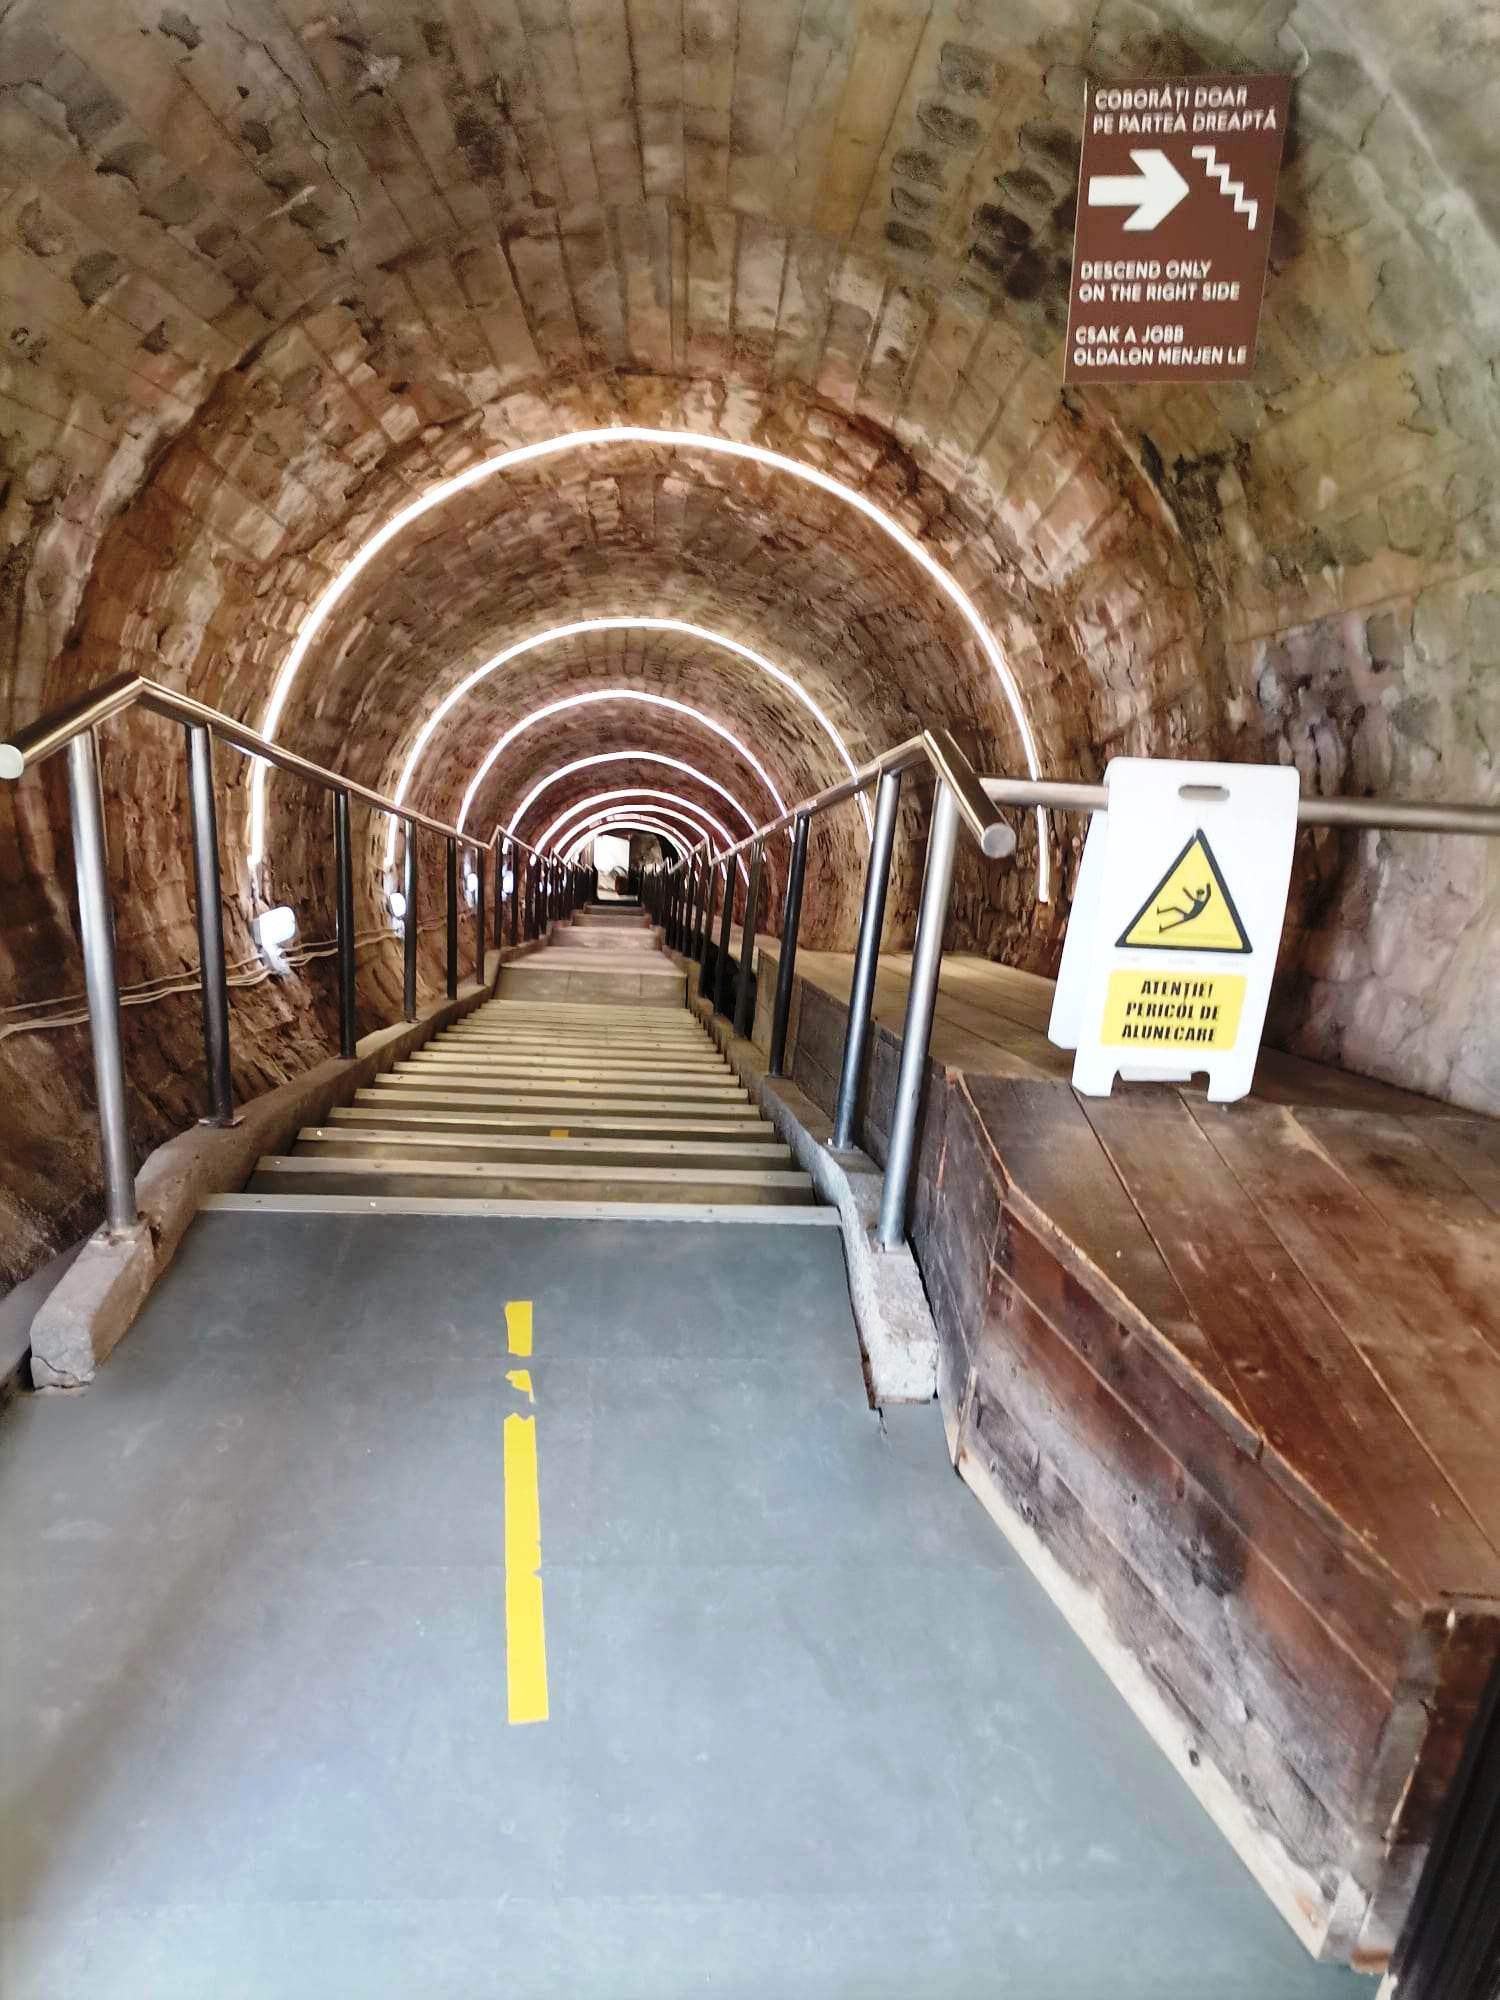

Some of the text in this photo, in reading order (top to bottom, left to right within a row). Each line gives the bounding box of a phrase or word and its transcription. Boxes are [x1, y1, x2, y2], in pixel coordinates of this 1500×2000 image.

[1194, 85, 1247, 108] DOAR
[1093, 112, 1114, 135] PE
[1118, 111, 1187, 134] PARTEA
[1080, 259, 1212, 280] DESCEND ONLY
[1079, 281, 1240, 303] ON THE RIGHT SIDE
[1075, 324, 1184, 344] CSAK A JOBB
[1073, 345, 1247, 366] OLDALON MENJEN LE
[1126, 1002, 1219, 1020] PERICOL DE
[1121, 1024, 1215, 1041] ALUNECARE
